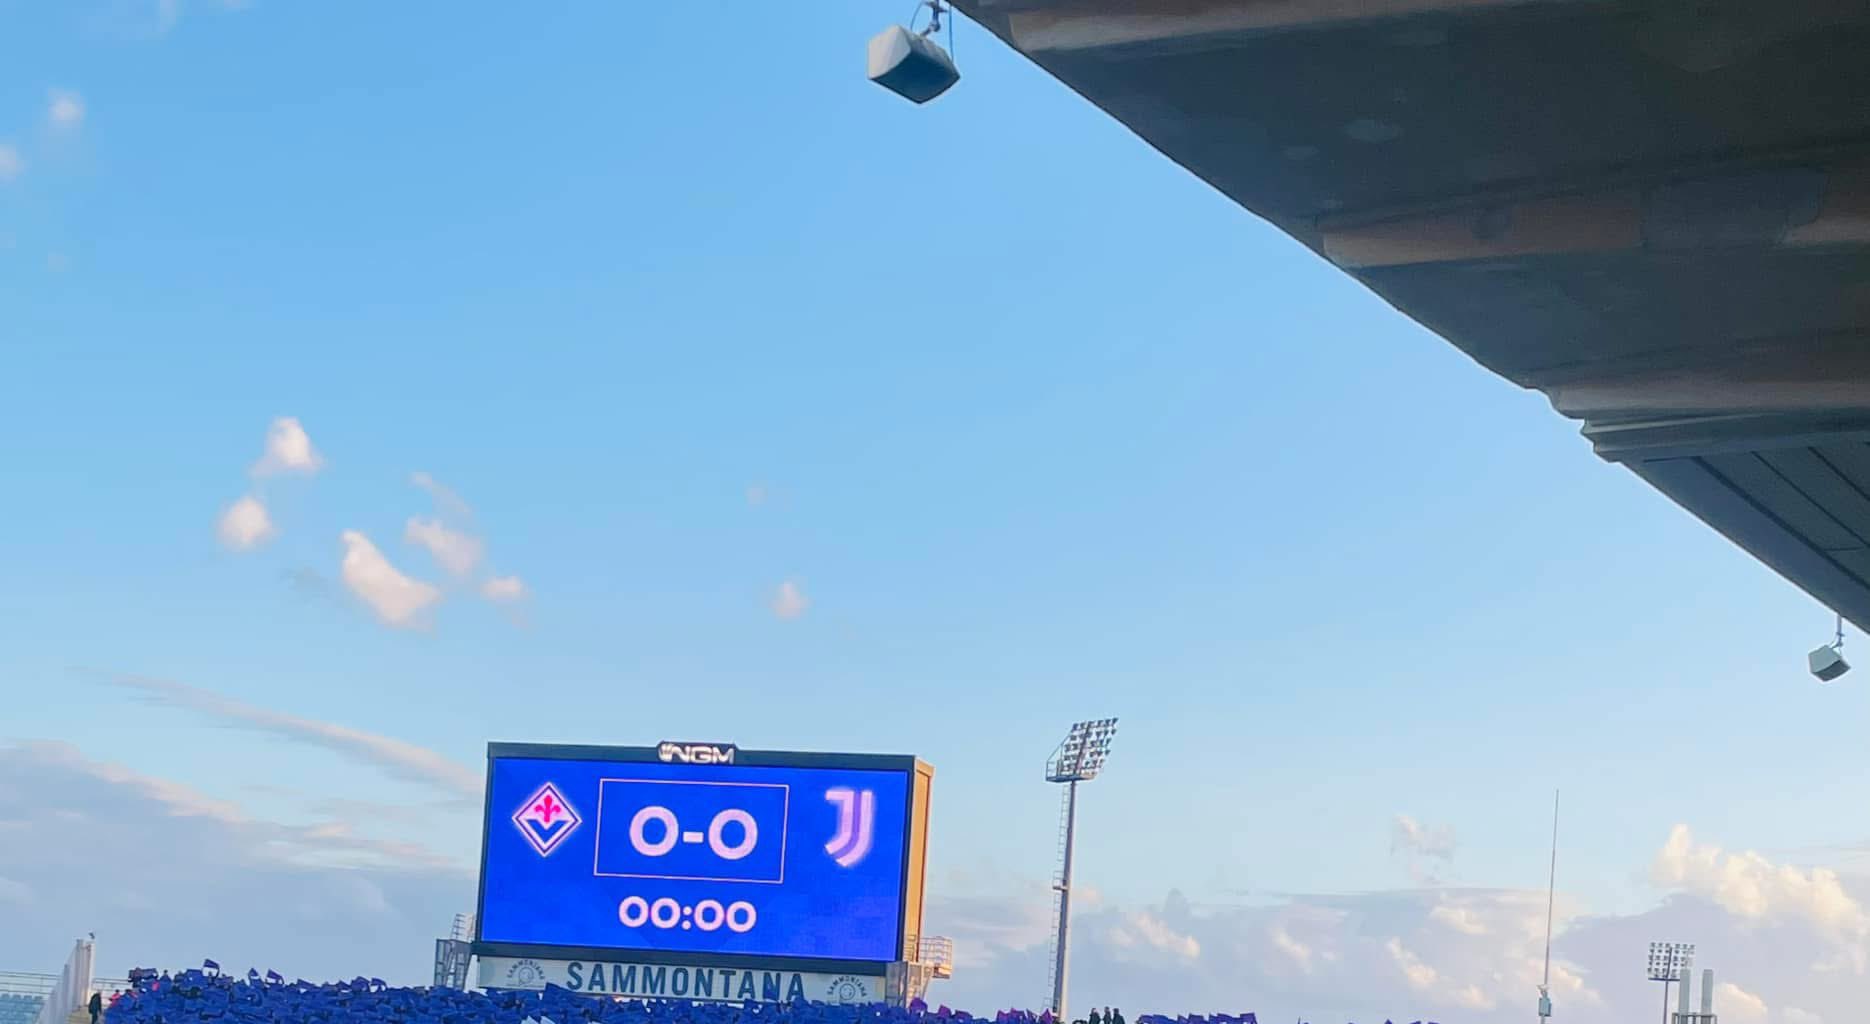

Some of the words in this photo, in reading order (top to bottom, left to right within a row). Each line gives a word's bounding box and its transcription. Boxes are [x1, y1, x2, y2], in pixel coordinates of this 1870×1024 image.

[629, 805, 758, 860] 0-0
[618, 896, 757, 932] 00:00
[565, 961, 805, 1001] SAMMONTANA
